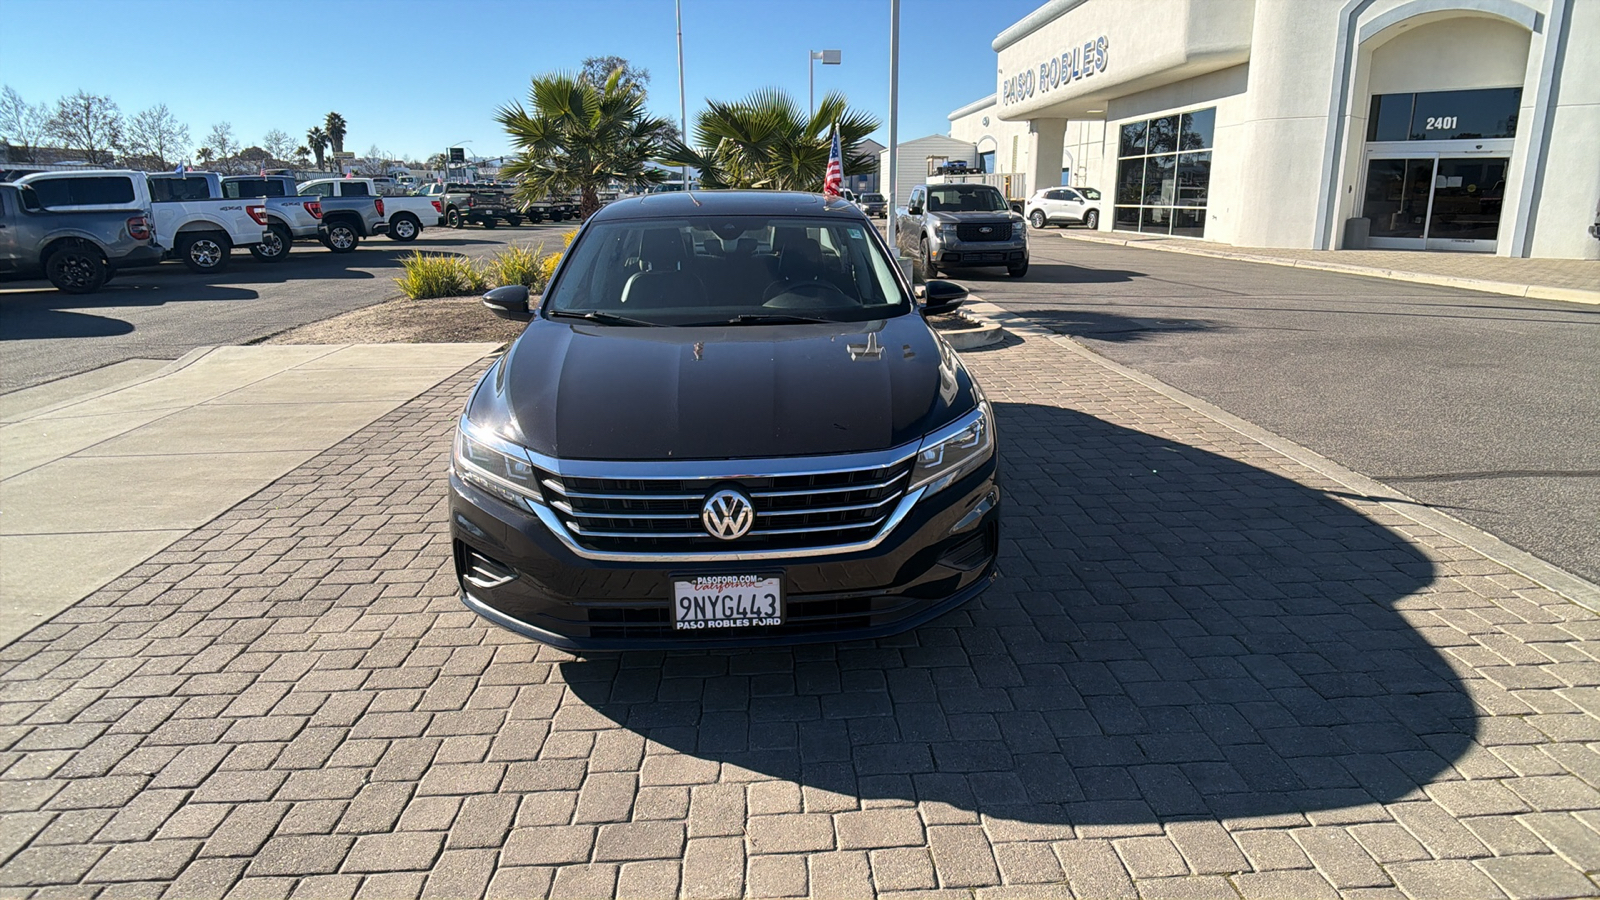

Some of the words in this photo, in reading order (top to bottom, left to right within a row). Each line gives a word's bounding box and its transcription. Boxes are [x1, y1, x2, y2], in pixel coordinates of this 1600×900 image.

[1003, 68, 1035, 105] PASO
[1039, 35, 1108, 93] ROBLES
[1425, 116, 1457, 130] 2401
[697, 575, 757, 585] PASOFORD.COM
[680, 593, 777, 620] 9NYG443
[676, 621, 705, 630] PASO
[707, 618, 750, 628] ROBLES
[752, 617, 781, 626] FORD
